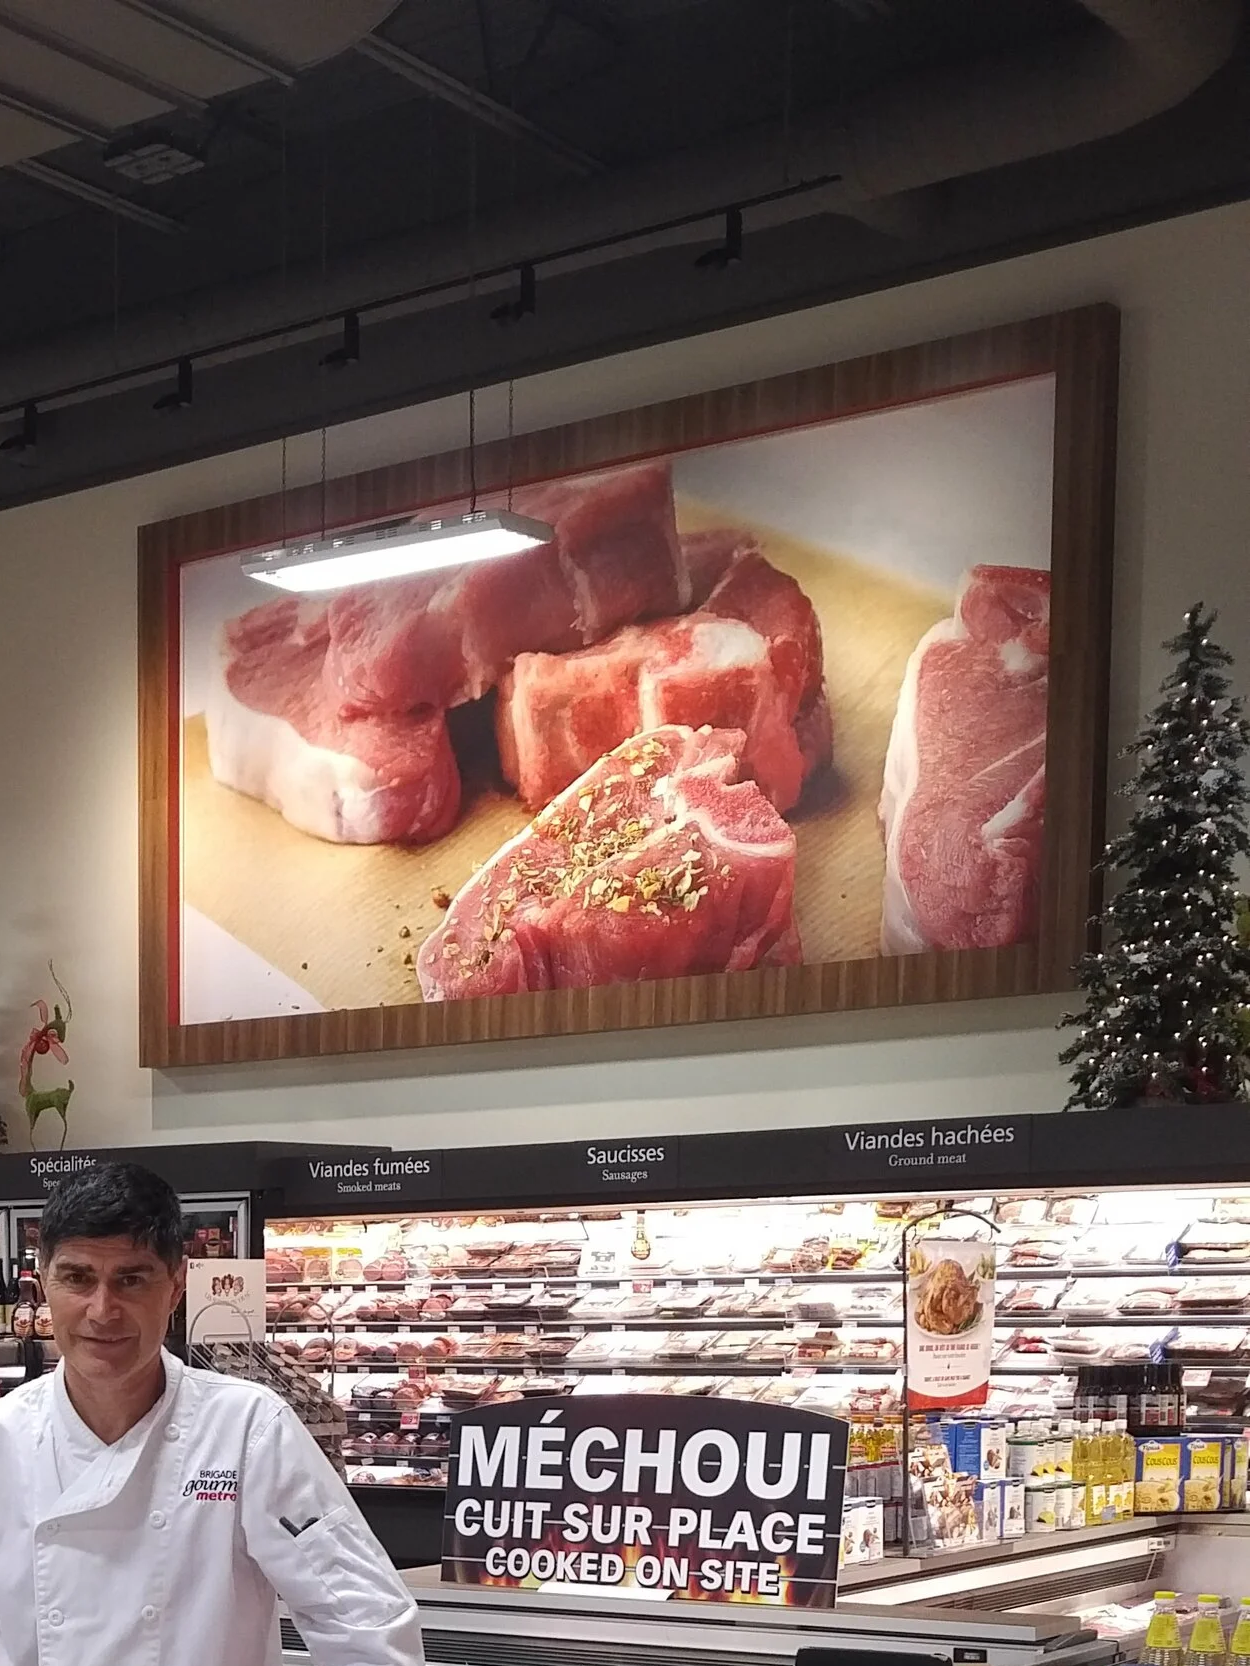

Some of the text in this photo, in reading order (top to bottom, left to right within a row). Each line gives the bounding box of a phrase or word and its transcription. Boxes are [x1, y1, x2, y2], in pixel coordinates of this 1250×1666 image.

[845, 1124, 1015, 1151] Viandes hachées
[587, 1144, 665, 1165] Saucisses
[888, 1153, 967, 1167] Ground meat
[309, 1157, 430, 1178] Viandes fumées
[602, 1169, 648, 1183] Sausages
[337, 1181, 401, 1193] Smoked meats
[457, 1409, 831, 1501] MÉCHOUI
[200, 1470, 237, 1479] BRIGADE
[196, 1491, 237, 1502] metro
[454, 1498, 826, 1555] CUIT SUR PLACE
[485, 1547, 781, 1594] COOKED ON SITE
